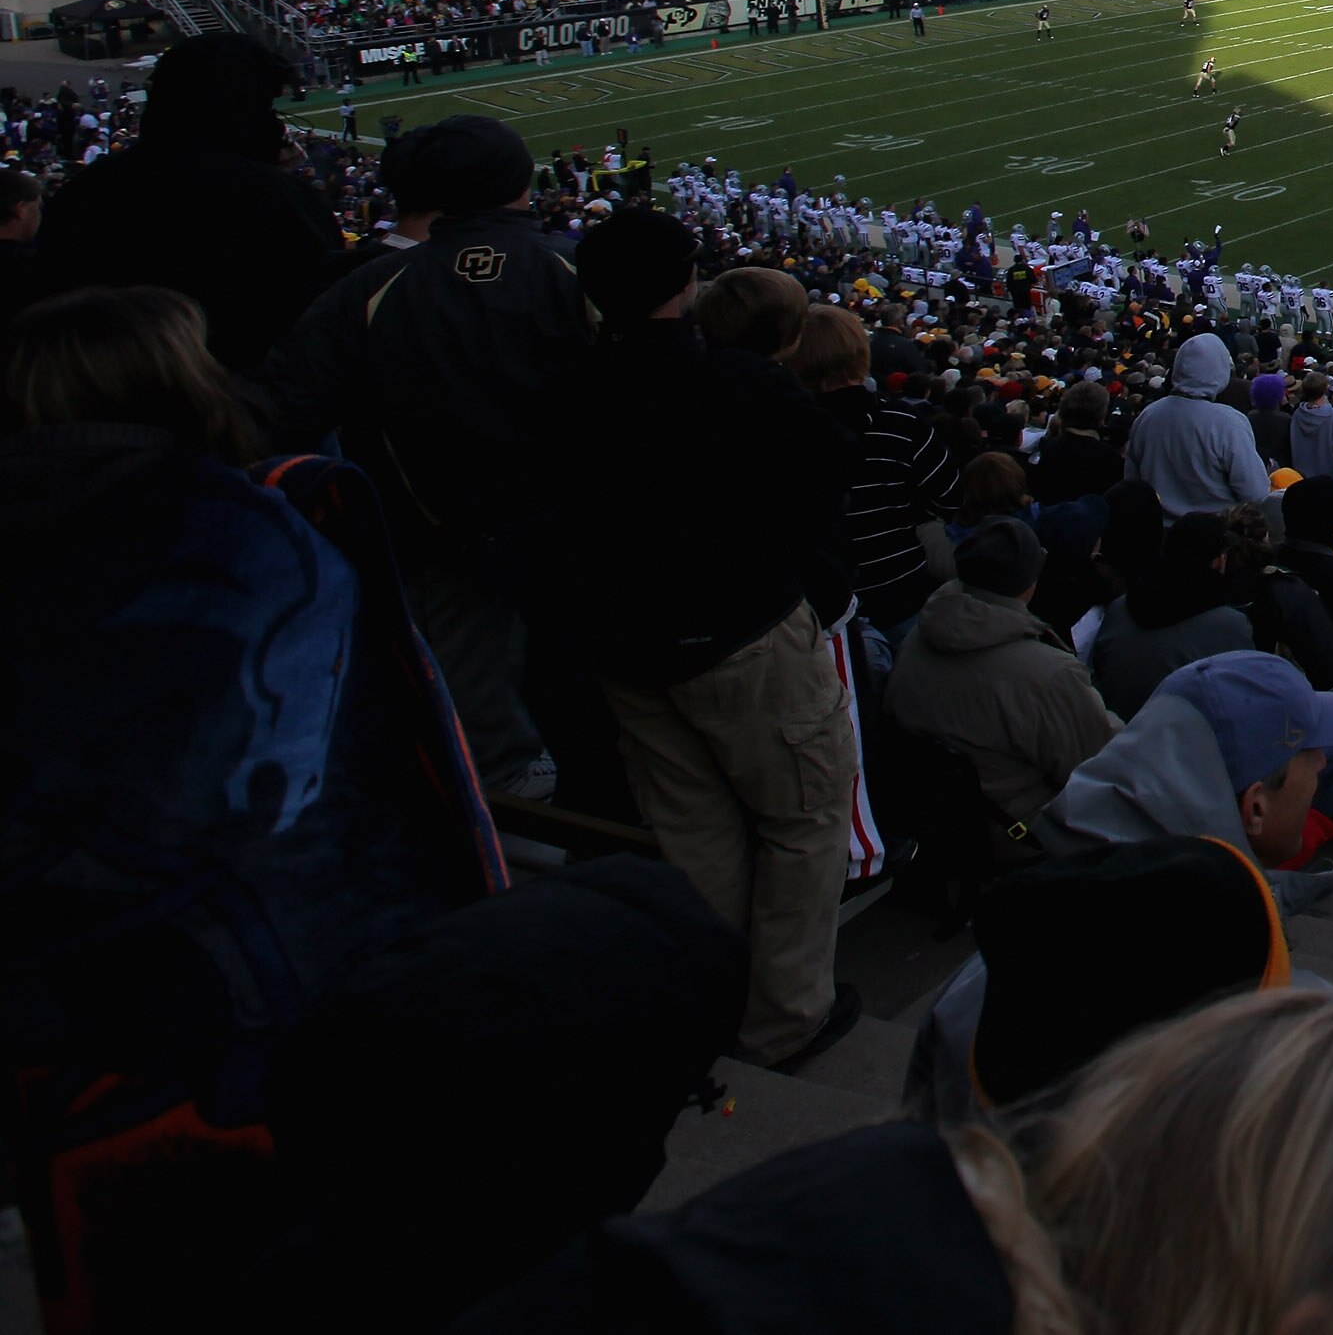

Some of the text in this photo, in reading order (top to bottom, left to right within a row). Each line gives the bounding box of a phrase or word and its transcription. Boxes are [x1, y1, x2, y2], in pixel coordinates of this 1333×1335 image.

[1004, 156, 1095, 174] 30
[1193, 181, 1287, 201] 40
[454, 245, 506, 283] CU
